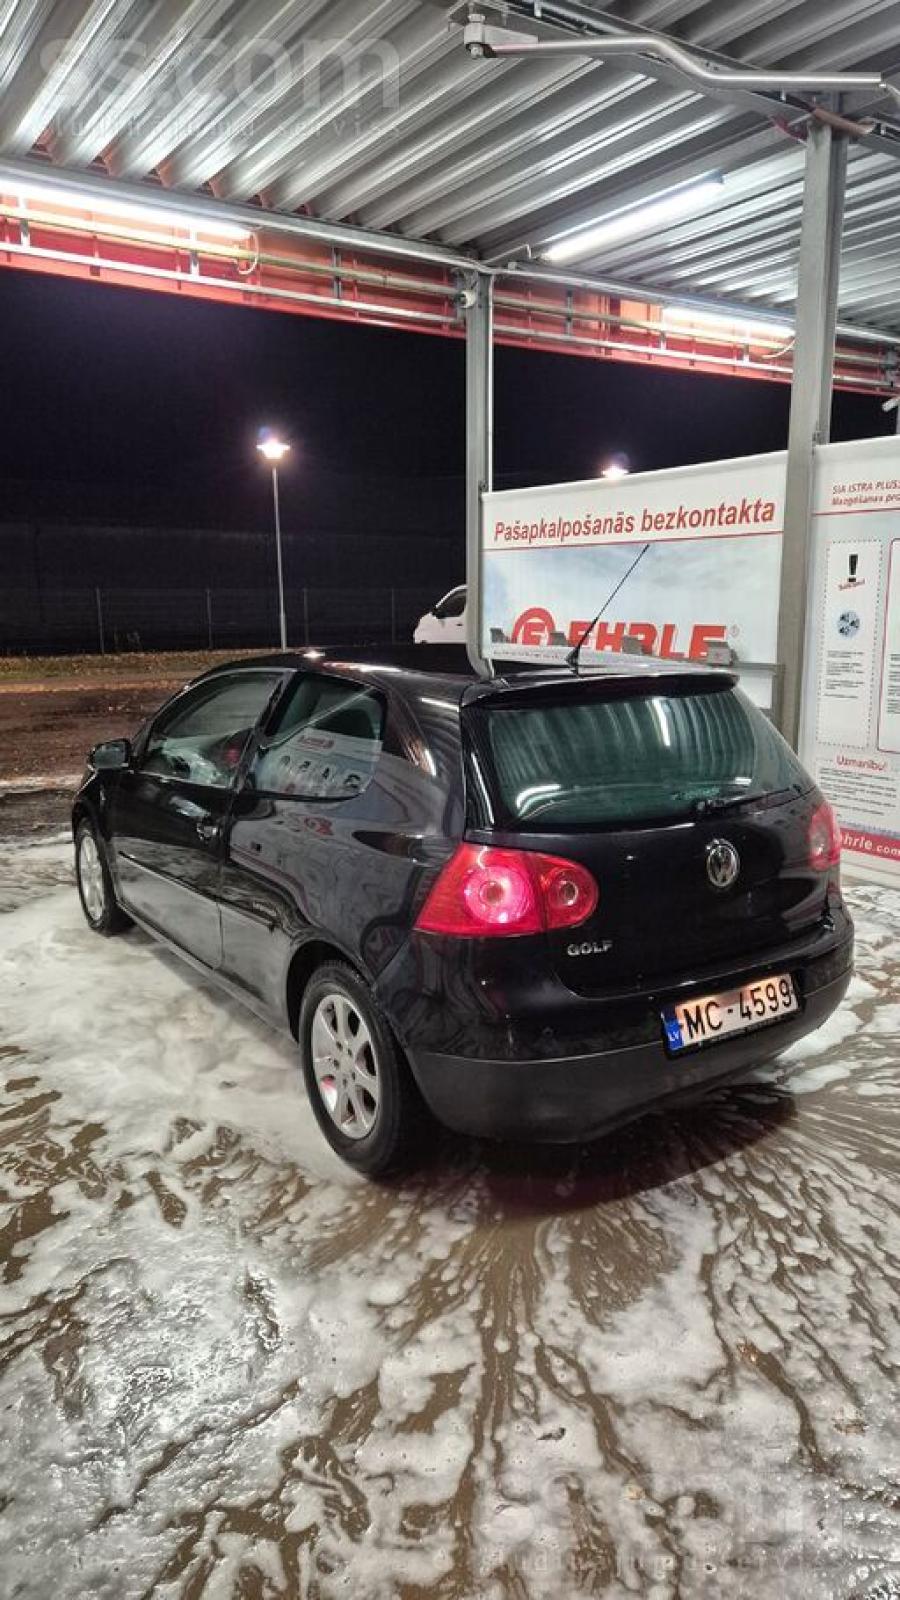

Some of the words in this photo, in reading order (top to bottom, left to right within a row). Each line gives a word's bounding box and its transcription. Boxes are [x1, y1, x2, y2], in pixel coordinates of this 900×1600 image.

[494, 515, 635, 544] Pašapkalpošanās
[641, 498, 776, 532] bezkontakta
[567, 940, 613, 957] GOLF
